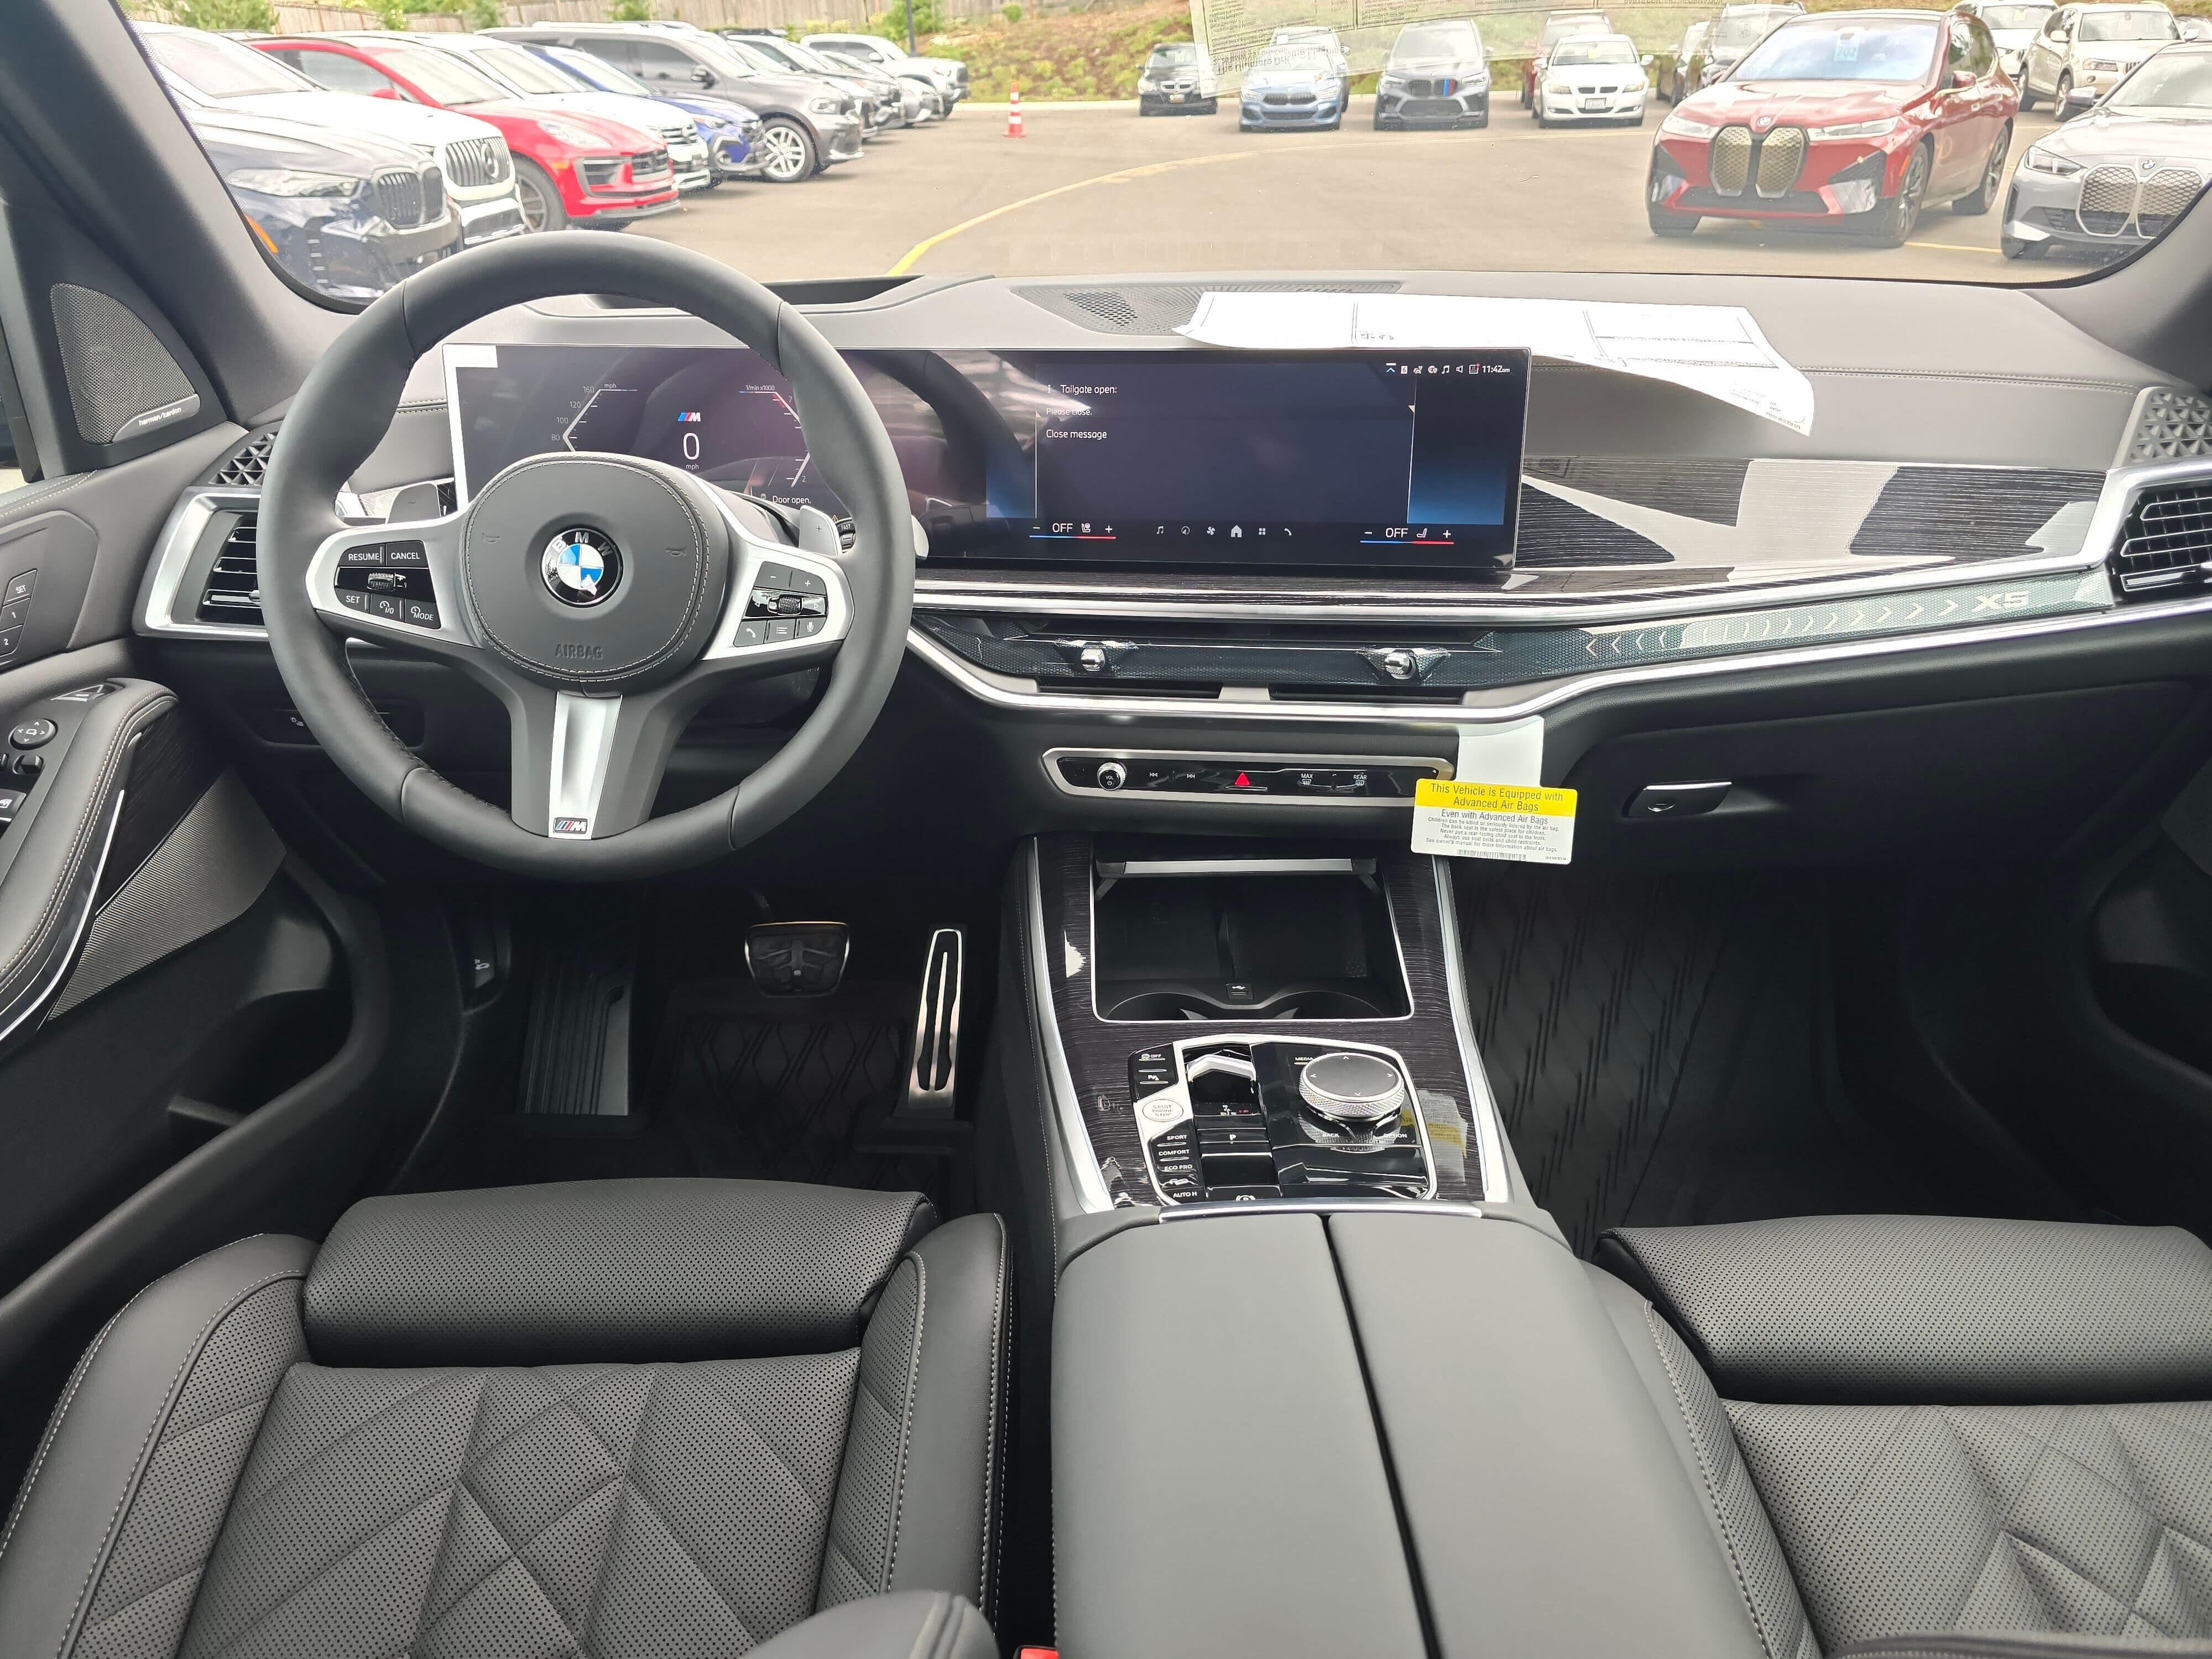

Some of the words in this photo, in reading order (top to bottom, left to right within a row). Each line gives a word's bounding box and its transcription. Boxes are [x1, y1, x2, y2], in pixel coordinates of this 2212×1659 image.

[1060, 384, 1092, 395] Tailgate
[139, 408, 181, 426] harman/kardon
[1046, 408, 1071, 416] Please
[1046, 429, 1068, 438] Close
[1070, 431, 1107, 440] message
[683, 432, 700, 460] 0
[772, 495, 791, 504] Door
[841, 523, 851, 531] FAST
[1052, 522, 1073, 534] OFF
[1385, 527, 1408, 539] OFF
[390, 551, 420, 560] CANCEL
[15, 585, 27, 594] SET
[346, 595, 361, 604] SET
[1973, 591, 2030, 612] X5
[413, 612, 434, 621] MODE
[555, 643, 603, 660] AIRBAG
[1431, 783, 1449, 794] This
[1453, 785, 1485, 796] Vehicle
[1489, 787, 1496, 797] is
[1499, 788, 1541, 801] Equipped
[1545, 792, 1563, 801] with
[1453, 796, 1498, 808] Advanced
[1500, 800, 1514, 809] Air
[1517, 801, 1538, 812] Bags
[1441, 809, 1459, 818] Even
[1462, 811, 1477, 819] with
[1479, 812, 1516, 822] Advanced
[1517, 815, 1528, 823] Air
[1530, 816, 1548, 825] Bags
